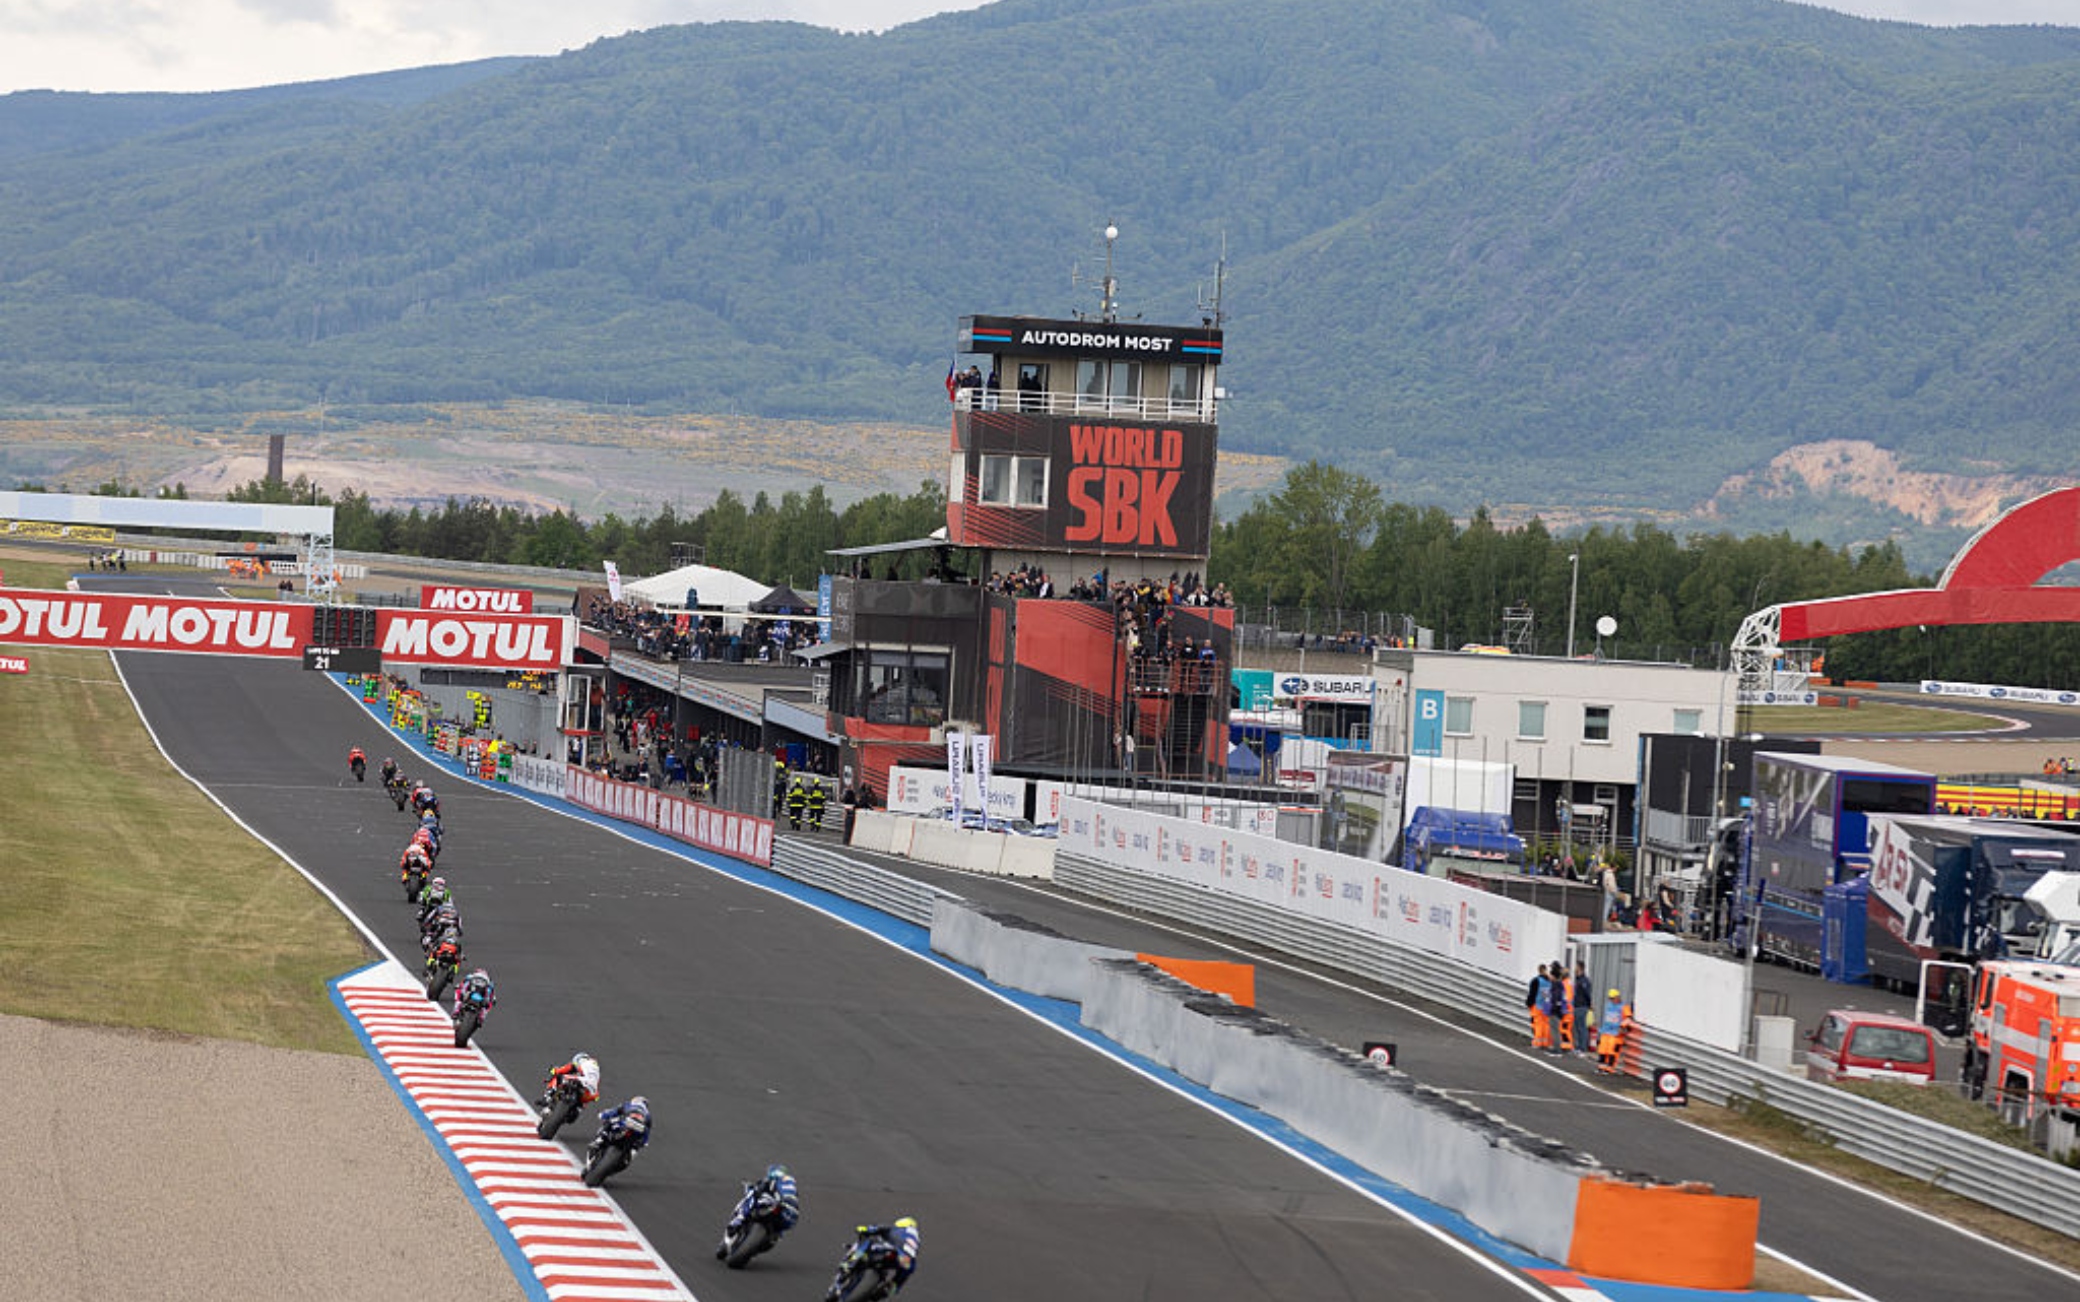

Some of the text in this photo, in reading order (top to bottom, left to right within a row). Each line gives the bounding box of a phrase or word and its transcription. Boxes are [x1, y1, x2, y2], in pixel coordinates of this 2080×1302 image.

[1021, 330, 1173, 351] AUTODROM MOST
[1069, 424, 1183, 469] WORLD
[1064, 466, 1183, 547] SBK
[430, 588, 523, 612] MOTUL
[121, 604, 296, 649] MOTUL
[382, 617, 553, 662] MOTUL
[314, 656, 330, 670] 21
[1313, 680, 1373, 694] SUBARU
[1421, 699, 1438, 720] B
